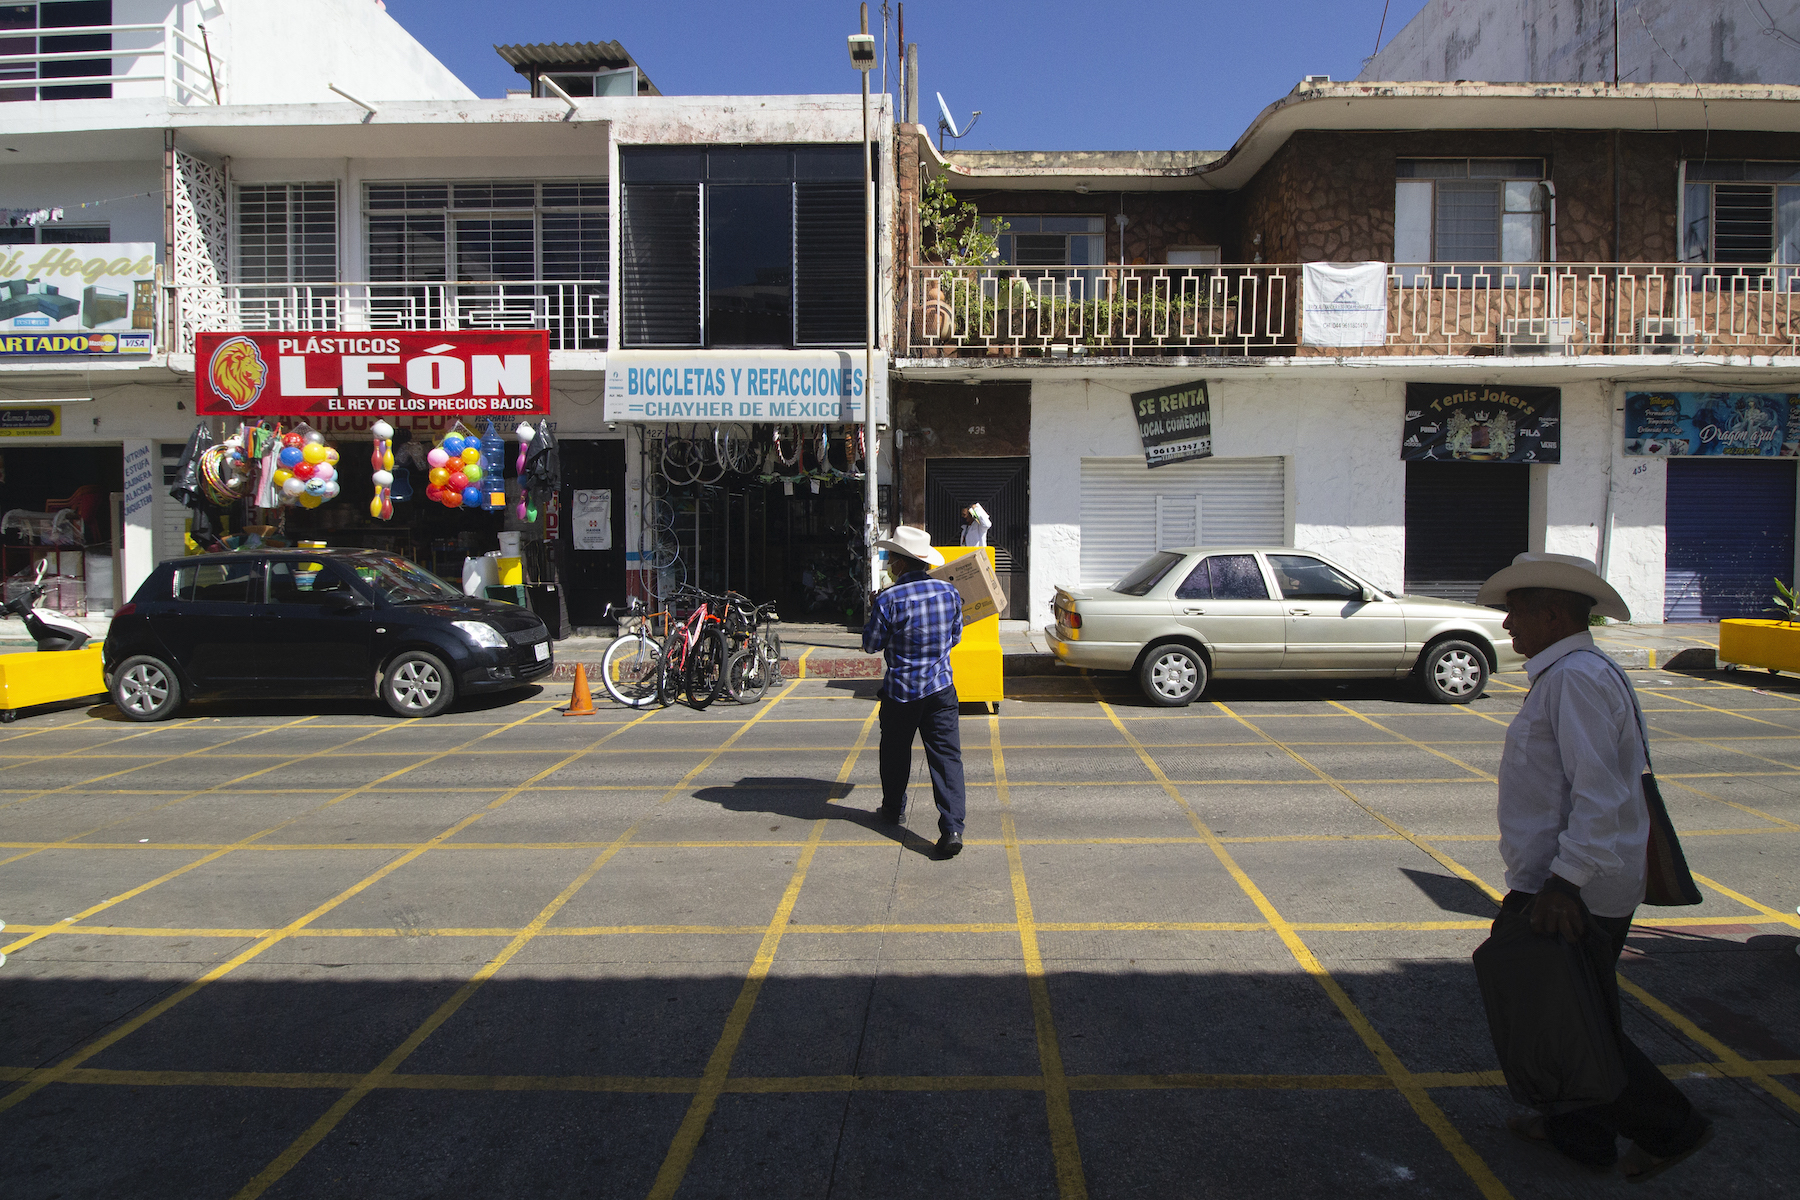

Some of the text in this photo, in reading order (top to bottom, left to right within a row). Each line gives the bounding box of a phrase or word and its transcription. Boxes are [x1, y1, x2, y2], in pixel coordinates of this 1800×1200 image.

[0, 250, 25, 278] i
[125, 339, 145, 347] VISA
[278, 336, 401, 354] PLÁSTICOS
[279, 343, 532, 397] LEÓN
[628, 367, 864, 396] BICICLETAS Y REFACCIONES
[328, 397, 534, 411] EL REY DE LOS PRECIOS BAJOS
[645, 399, 843, 417] CHAYHER DE MÉXICO
[1139, 388, 1205, 417] SE RENTA
[1430, 389, 1535, 416] Tenis Jokers
[1, 411, 50, 423] Camas Imperio
[1139, 420, 1164, 438] LOCAL
[1520, 428, 1540, 437] FILA
[1700, 424, 1748, 446] Dragon
[1750, 425, 1777, 447] azul
[124, 445, 150, 464] VITRINA
[1540, 441, 1557, 449] VANS
[125, 458, 150, 477] ESTUFA
[124, 470, 152, 489] CAJONERA
[125, 482, 153, 503] ALACENA
